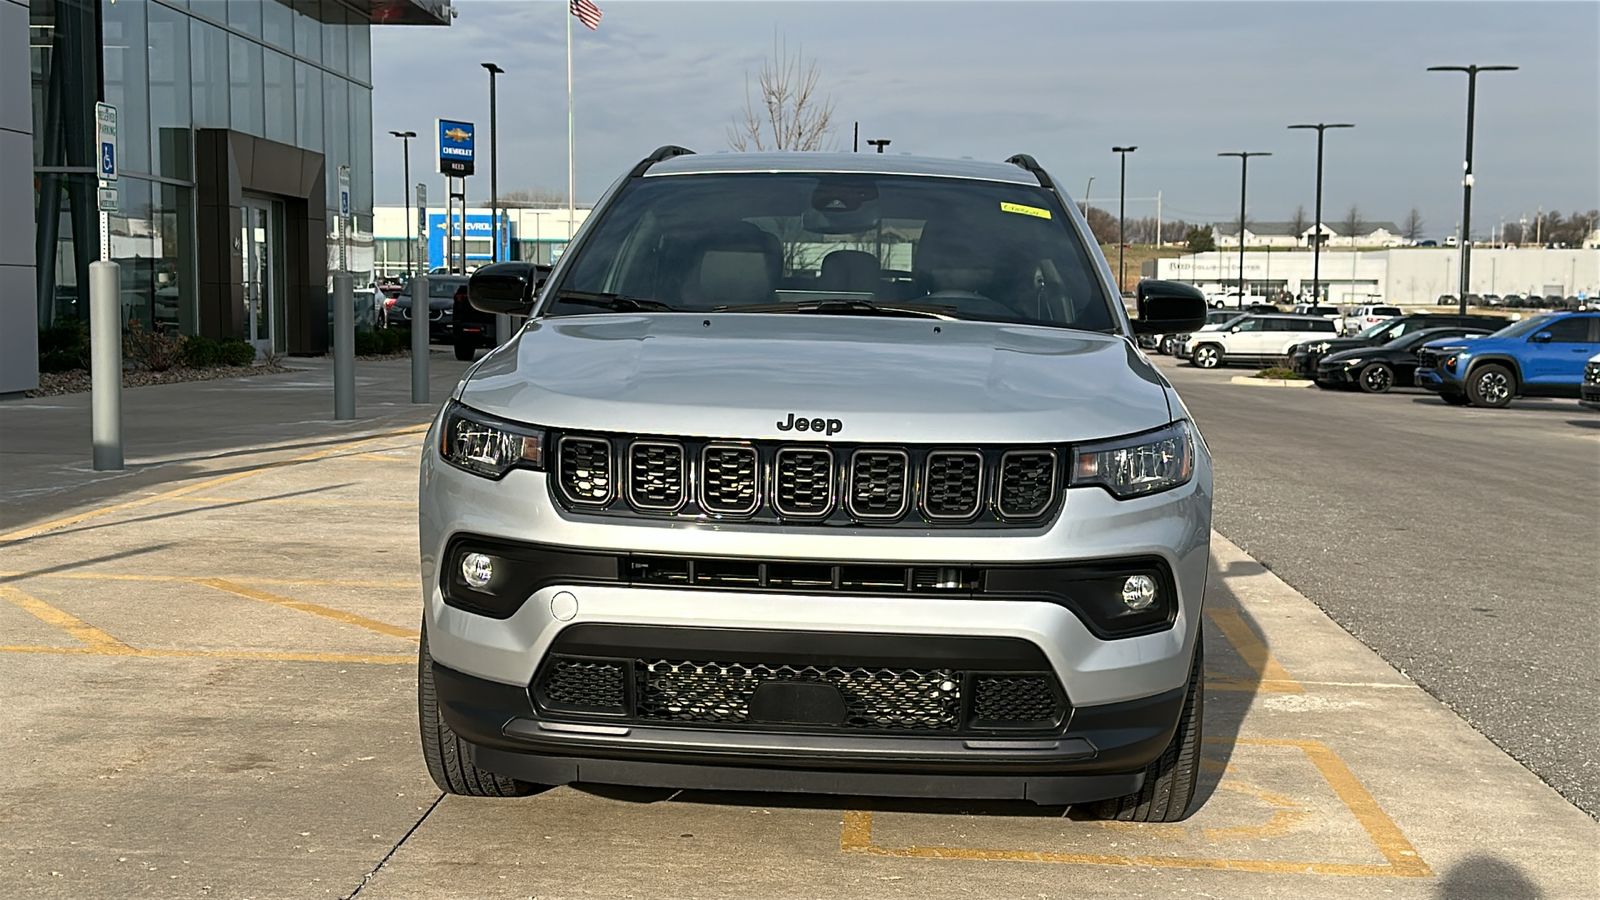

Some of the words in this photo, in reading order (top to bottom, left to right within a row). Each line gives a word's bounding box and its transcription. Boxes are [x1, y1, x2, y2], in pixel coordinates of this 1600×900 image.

[443, 146, 472, 156] CHEVROLET
[454, 222, 502, 231] CEVROLT
[776, 413, 843, 436] Jeep
